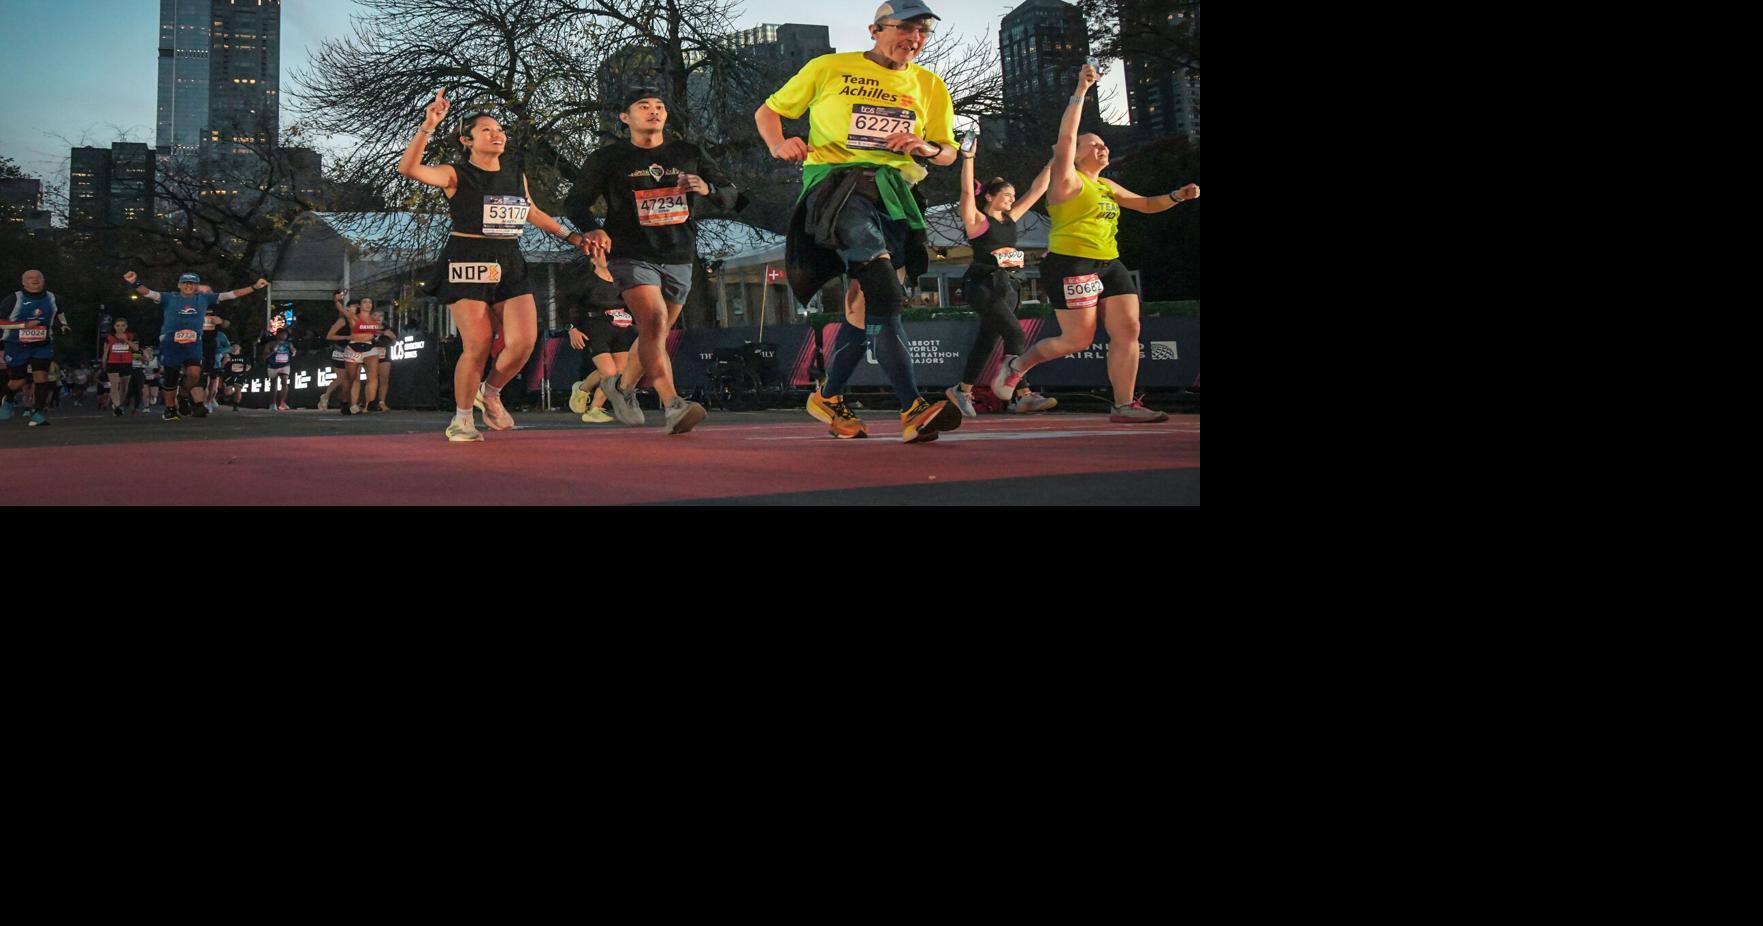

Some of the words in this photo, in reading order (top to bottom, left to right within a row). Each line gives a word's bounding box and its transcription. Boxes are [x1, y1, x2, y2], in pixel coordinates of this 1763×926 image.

[842, 74, 879, 86] Team
[839, 86, 898, 102] Achilles
[855, 115, 910, 133] 62273
[641, 196, 684, 210] 47234
[489, 206, 527, 219] 53170
[1067, 281, 1102, 295] 50682
